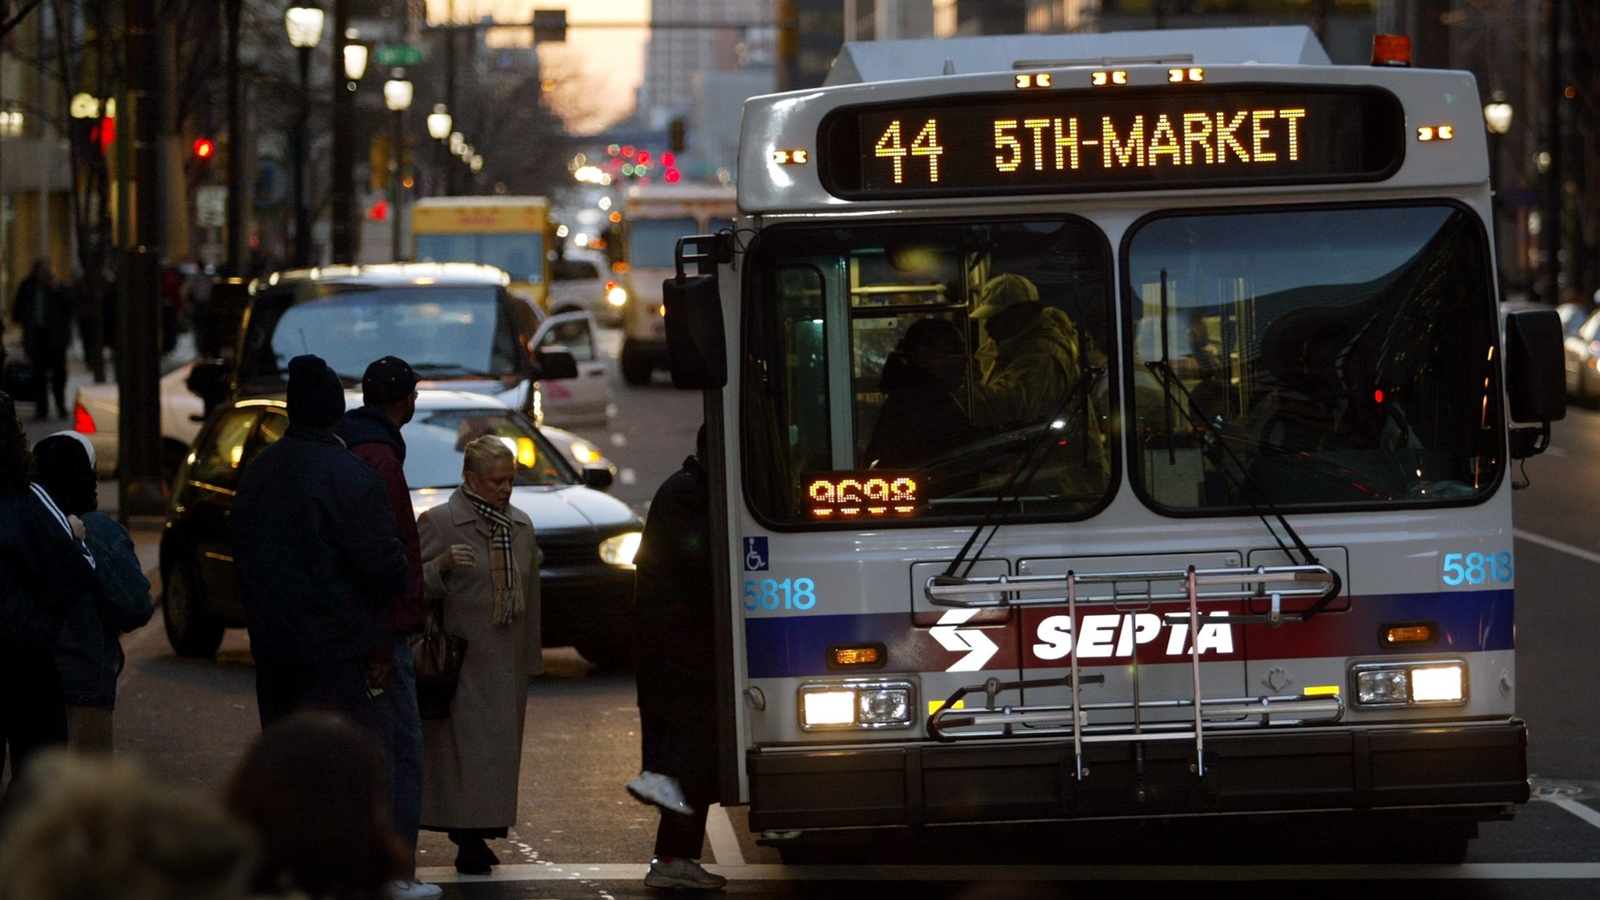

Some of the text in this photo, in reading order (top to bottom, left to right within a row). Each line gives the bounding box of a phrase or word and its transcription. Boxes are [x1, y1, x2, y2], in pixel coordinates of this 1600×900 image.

[875, 108, 1306, 184] 44 5TH-MARKET
[1442, 551, 1514, 587] 5818
[743, 577, 817, 611] 5818
[1032, 610, 1234, 661] SEPTA
